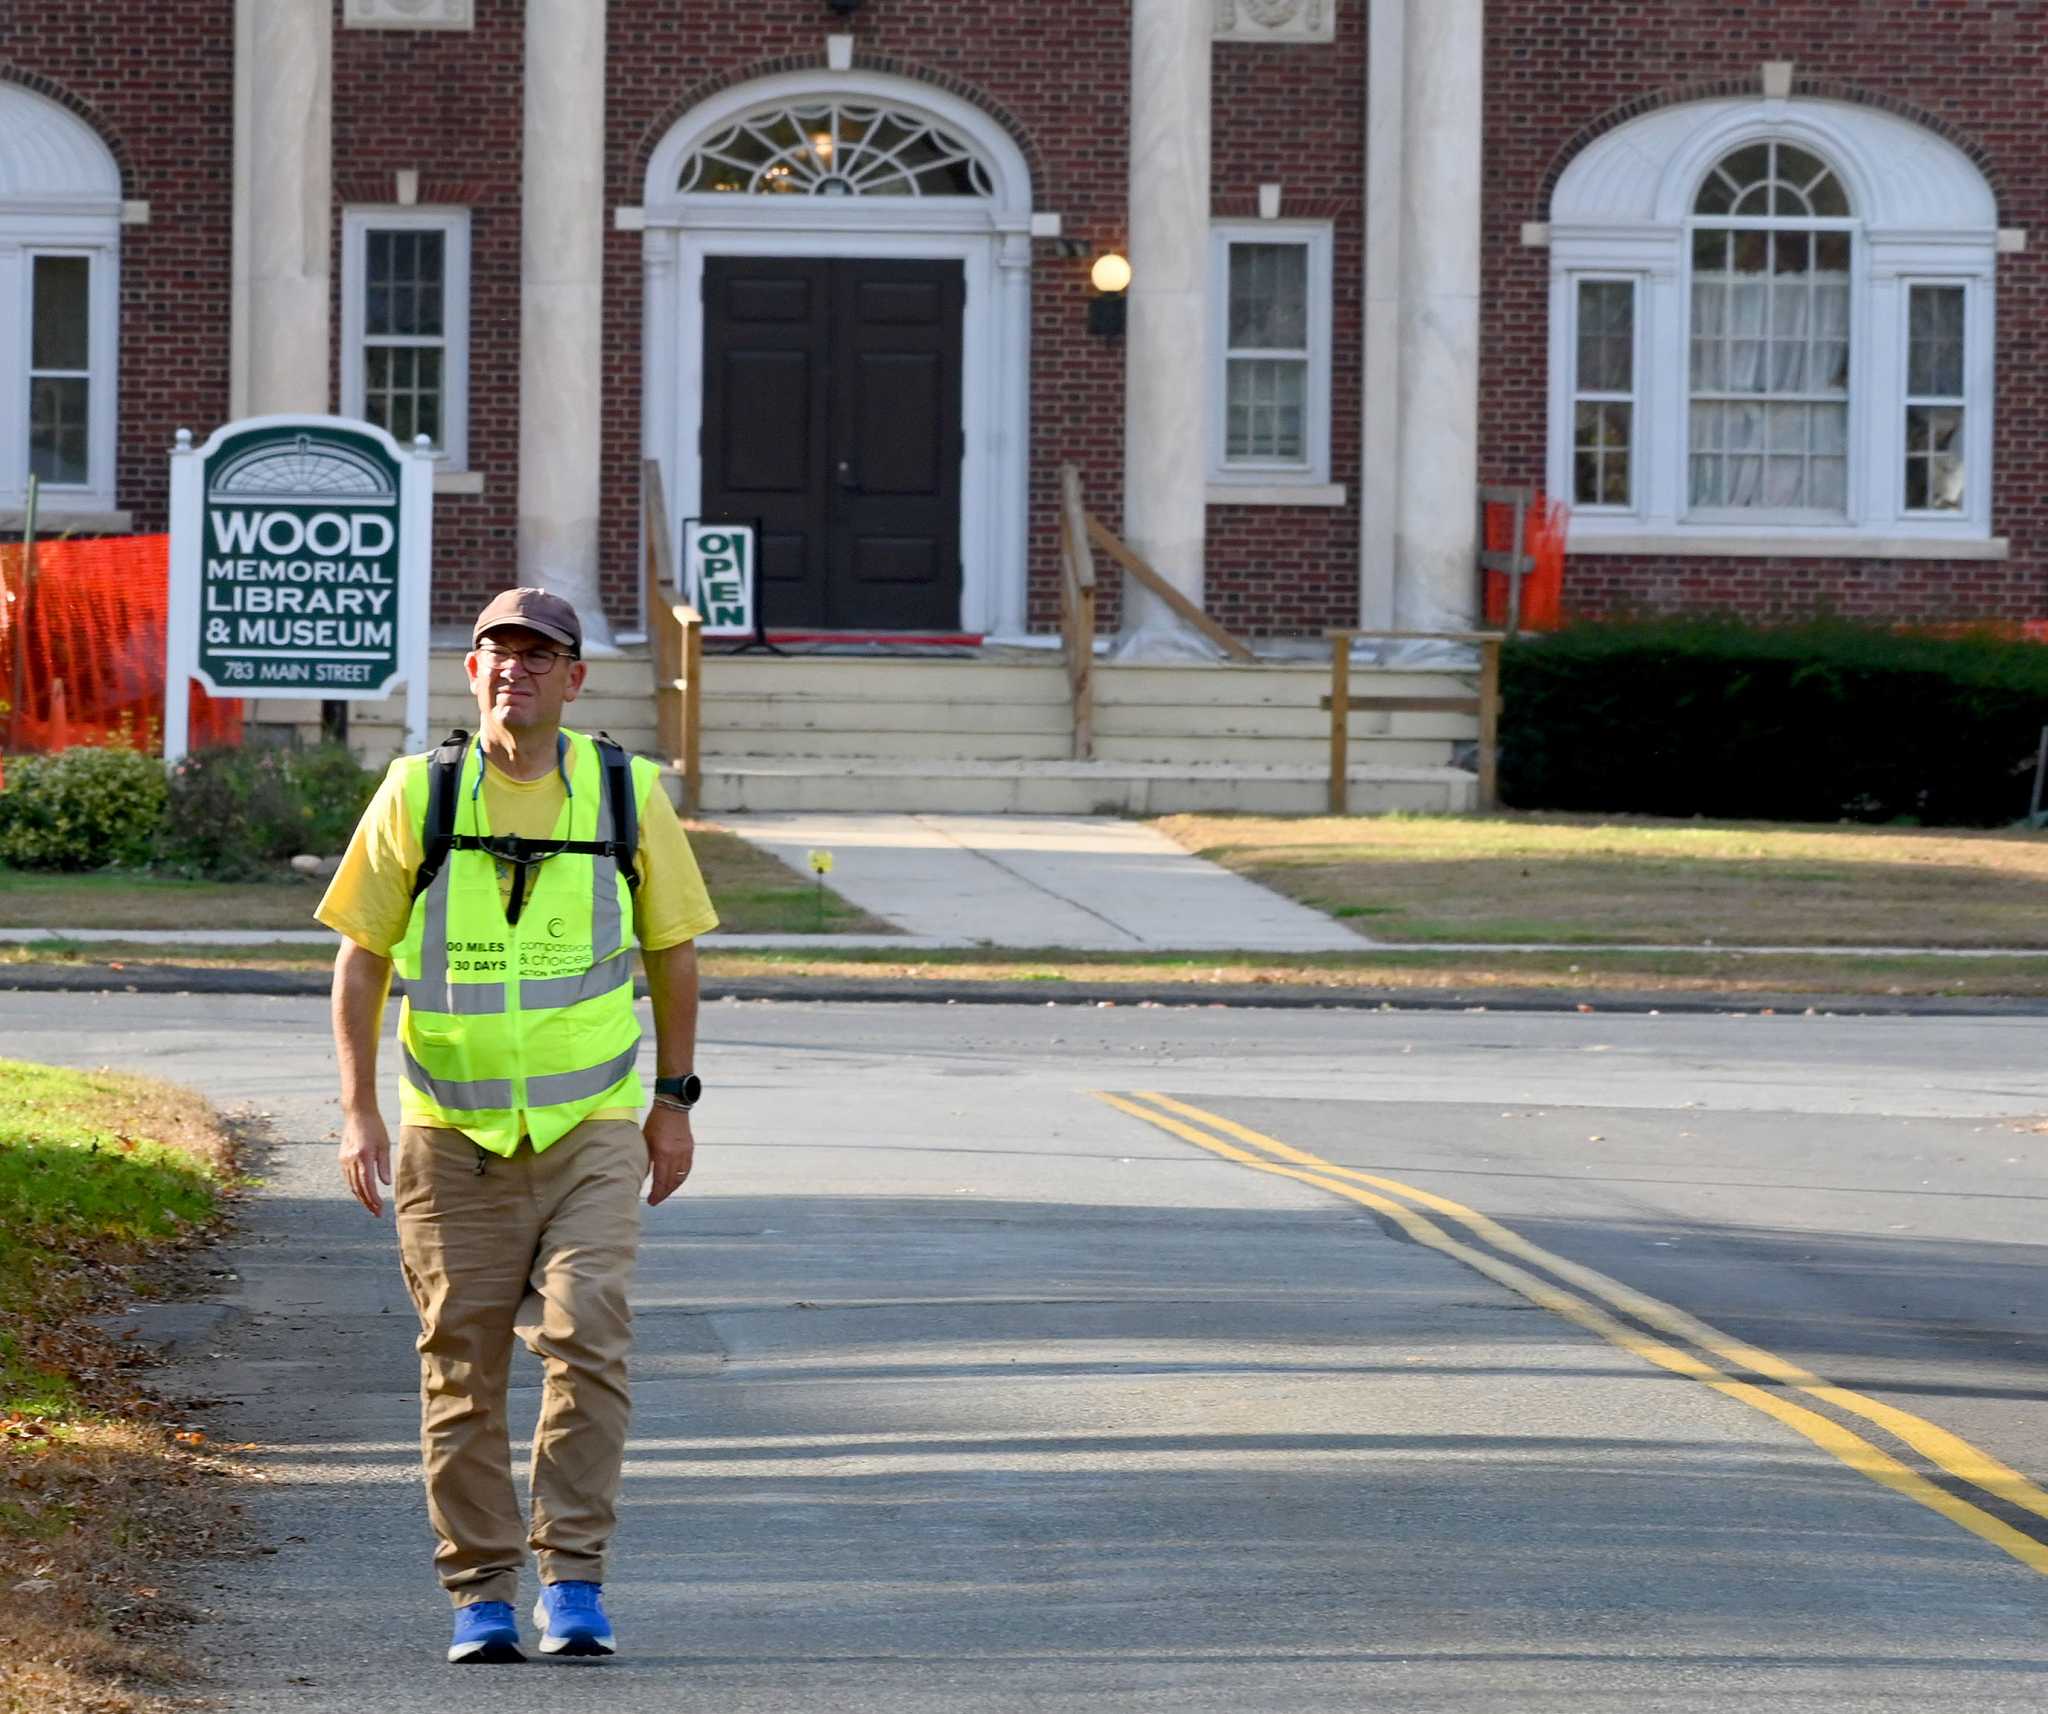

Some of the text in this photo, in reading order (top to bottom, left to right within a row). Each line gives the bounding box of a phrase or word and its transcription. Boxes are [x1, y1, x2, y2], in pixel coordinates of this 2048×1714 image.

[210, 511, 394, 556] WOOD
[207, 559, 393, 584] MEMORIAL
[698, 534, 745, 627] OPEN
[207, 586, 392, 615] LIBRARY
[206, 617, 392, 647] & MUSEUM
[223, 661, 373, 682] 783 MAIN STREET
[466, 942, 505, 952] MILES
[454, 960, 471, 971] 30
[474, 960, 507, 971] DAYS
[531, 953, 592, 967] choices
